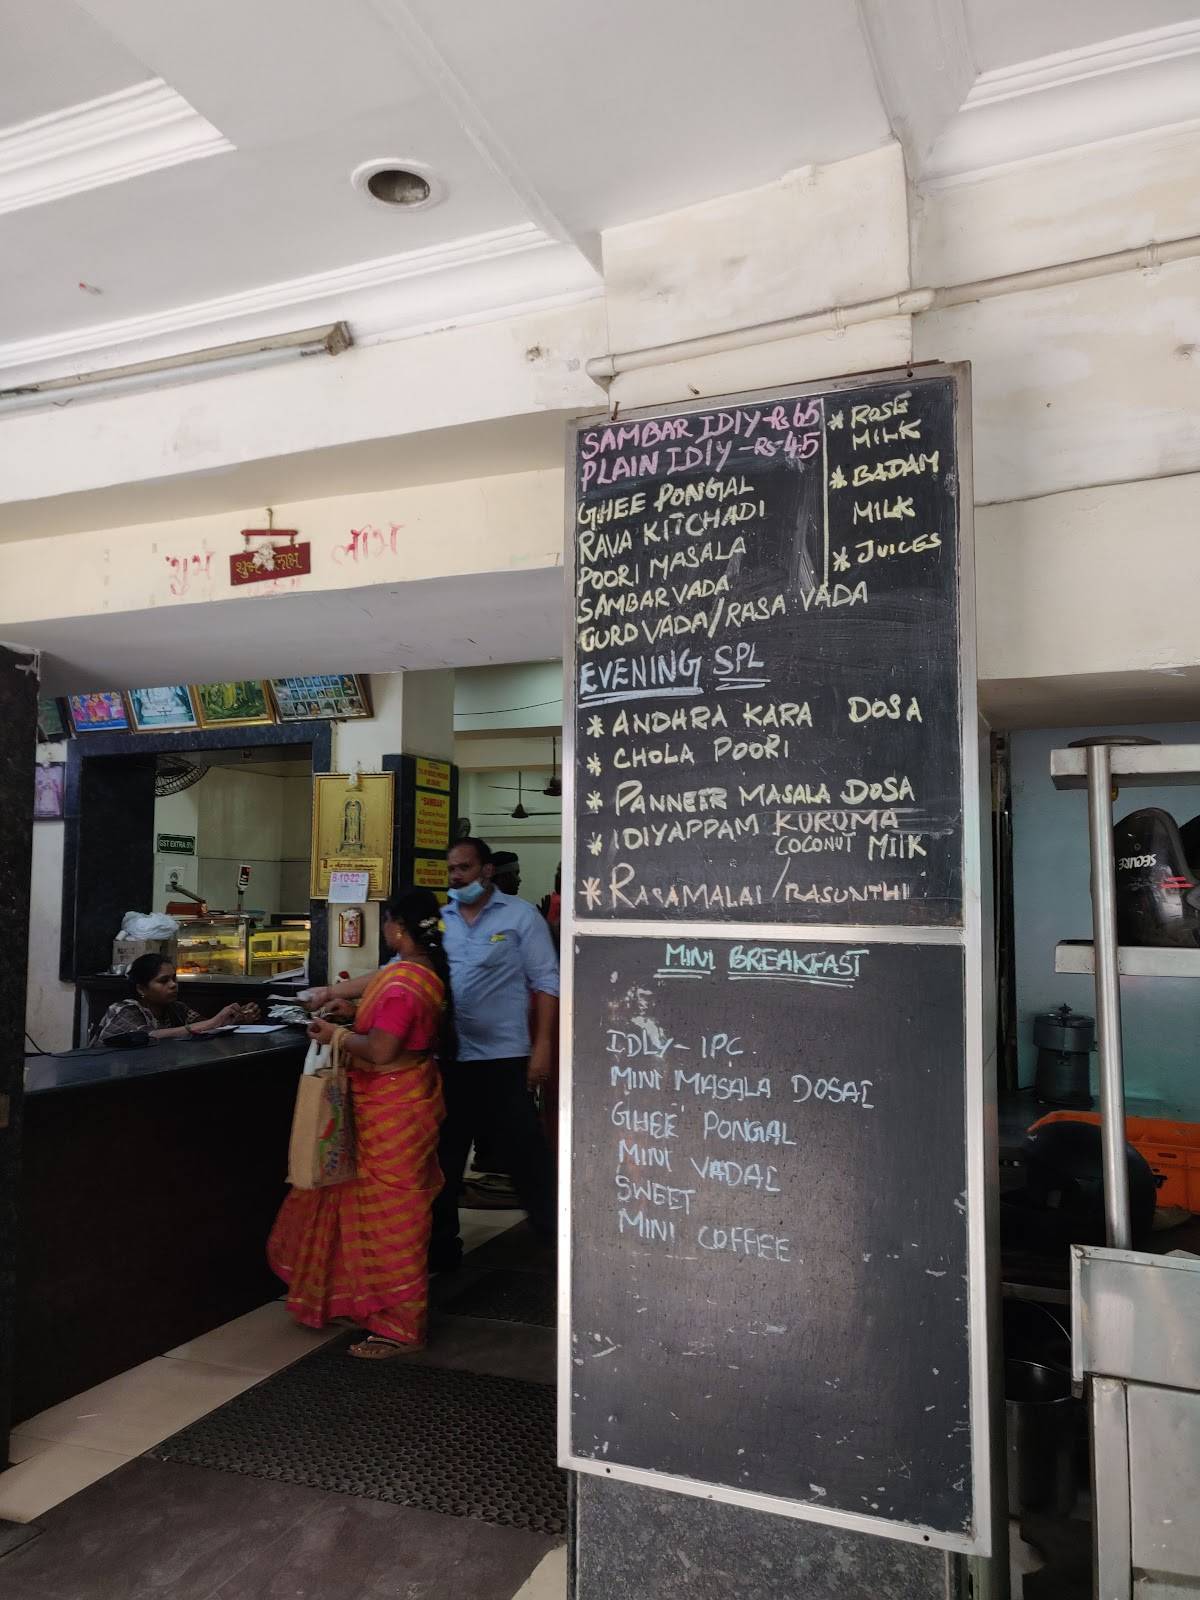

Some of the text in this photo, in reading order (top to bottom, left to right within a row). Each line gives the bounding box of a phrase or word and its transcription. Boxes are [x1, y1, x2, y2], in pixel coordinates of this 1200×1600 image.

[850, 391, 912, 429] ROSE
[580, 418, 694, 460] SAMBAR
[793, 400, 821, 427] 65
[852, 418, 922, 450] MILK
[580, 450, 660, 492] PLAIN
[852, 450, 940, 487] BADAM
[577, 475, 755, 531] GHEE PONGAL
[853, 496, 916, 525] MILK
[578, 500, 765, 564] RAVA KITCHADI
[855, 532, 942, 563] JUICES
[577, 536, 747, 597] POORI MASALA
[577, 574, 730, 624] SAMBAR VADA
[800, 580, 868, 612] VADA
[580, 642, 766, 694] EVENING SPL
[612, 693, 923, 737] ANDHRA KARA DOSA
[613, 735, 789, 769] CHOLA POORI
[738, 783, 831, 807] MASALA
[840, 776, 916, 805] DOSA
[612, 813, 760, 851] IDIYAPPAM
[775, 832, 856, 856] COCONUT
[665, 943, 870, 977] MINI BREAKFAST
[611, 1066, 875, 1109] MINI MASALA DOSAI
[611, 1101, 798, 1146] GHEE PONGAL
[618, 1139, 673, 1173] MINI
[615, 1174, 696, 1215] SWEET
[618, 1207, 792, 1263] MINI COFFEE
